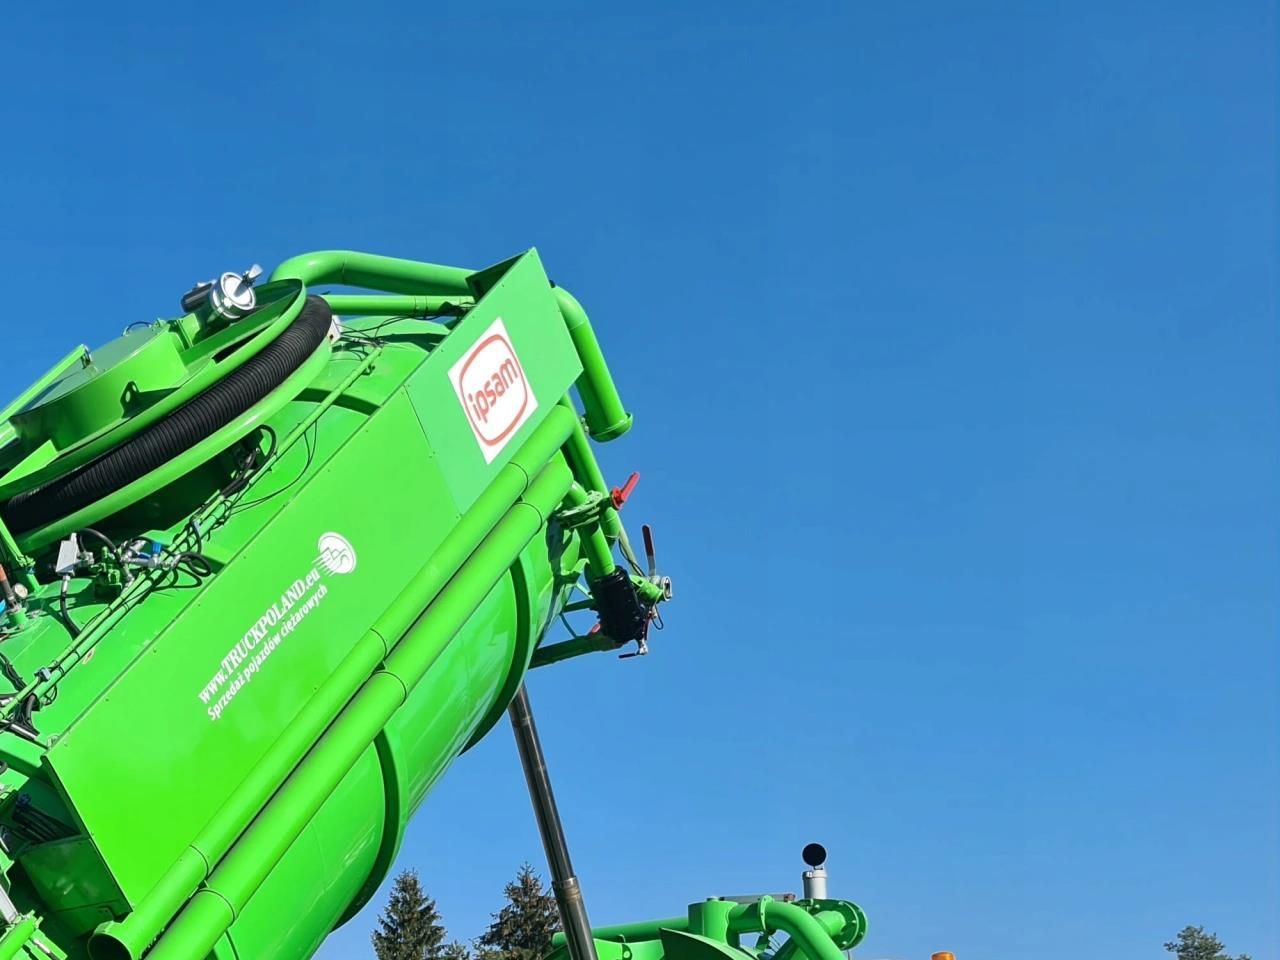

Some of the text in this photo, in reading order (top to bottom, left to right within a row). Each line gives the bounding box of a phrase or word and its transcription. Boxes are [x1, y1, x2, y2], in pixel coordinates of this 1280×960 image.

[468, 358, 518, 424] ipsam
[198, 567, 321, 704] www.TRUCKPOLAND.eu
[207, 583, 328, 721] Sprzedaż pojazdów ciężarowych
